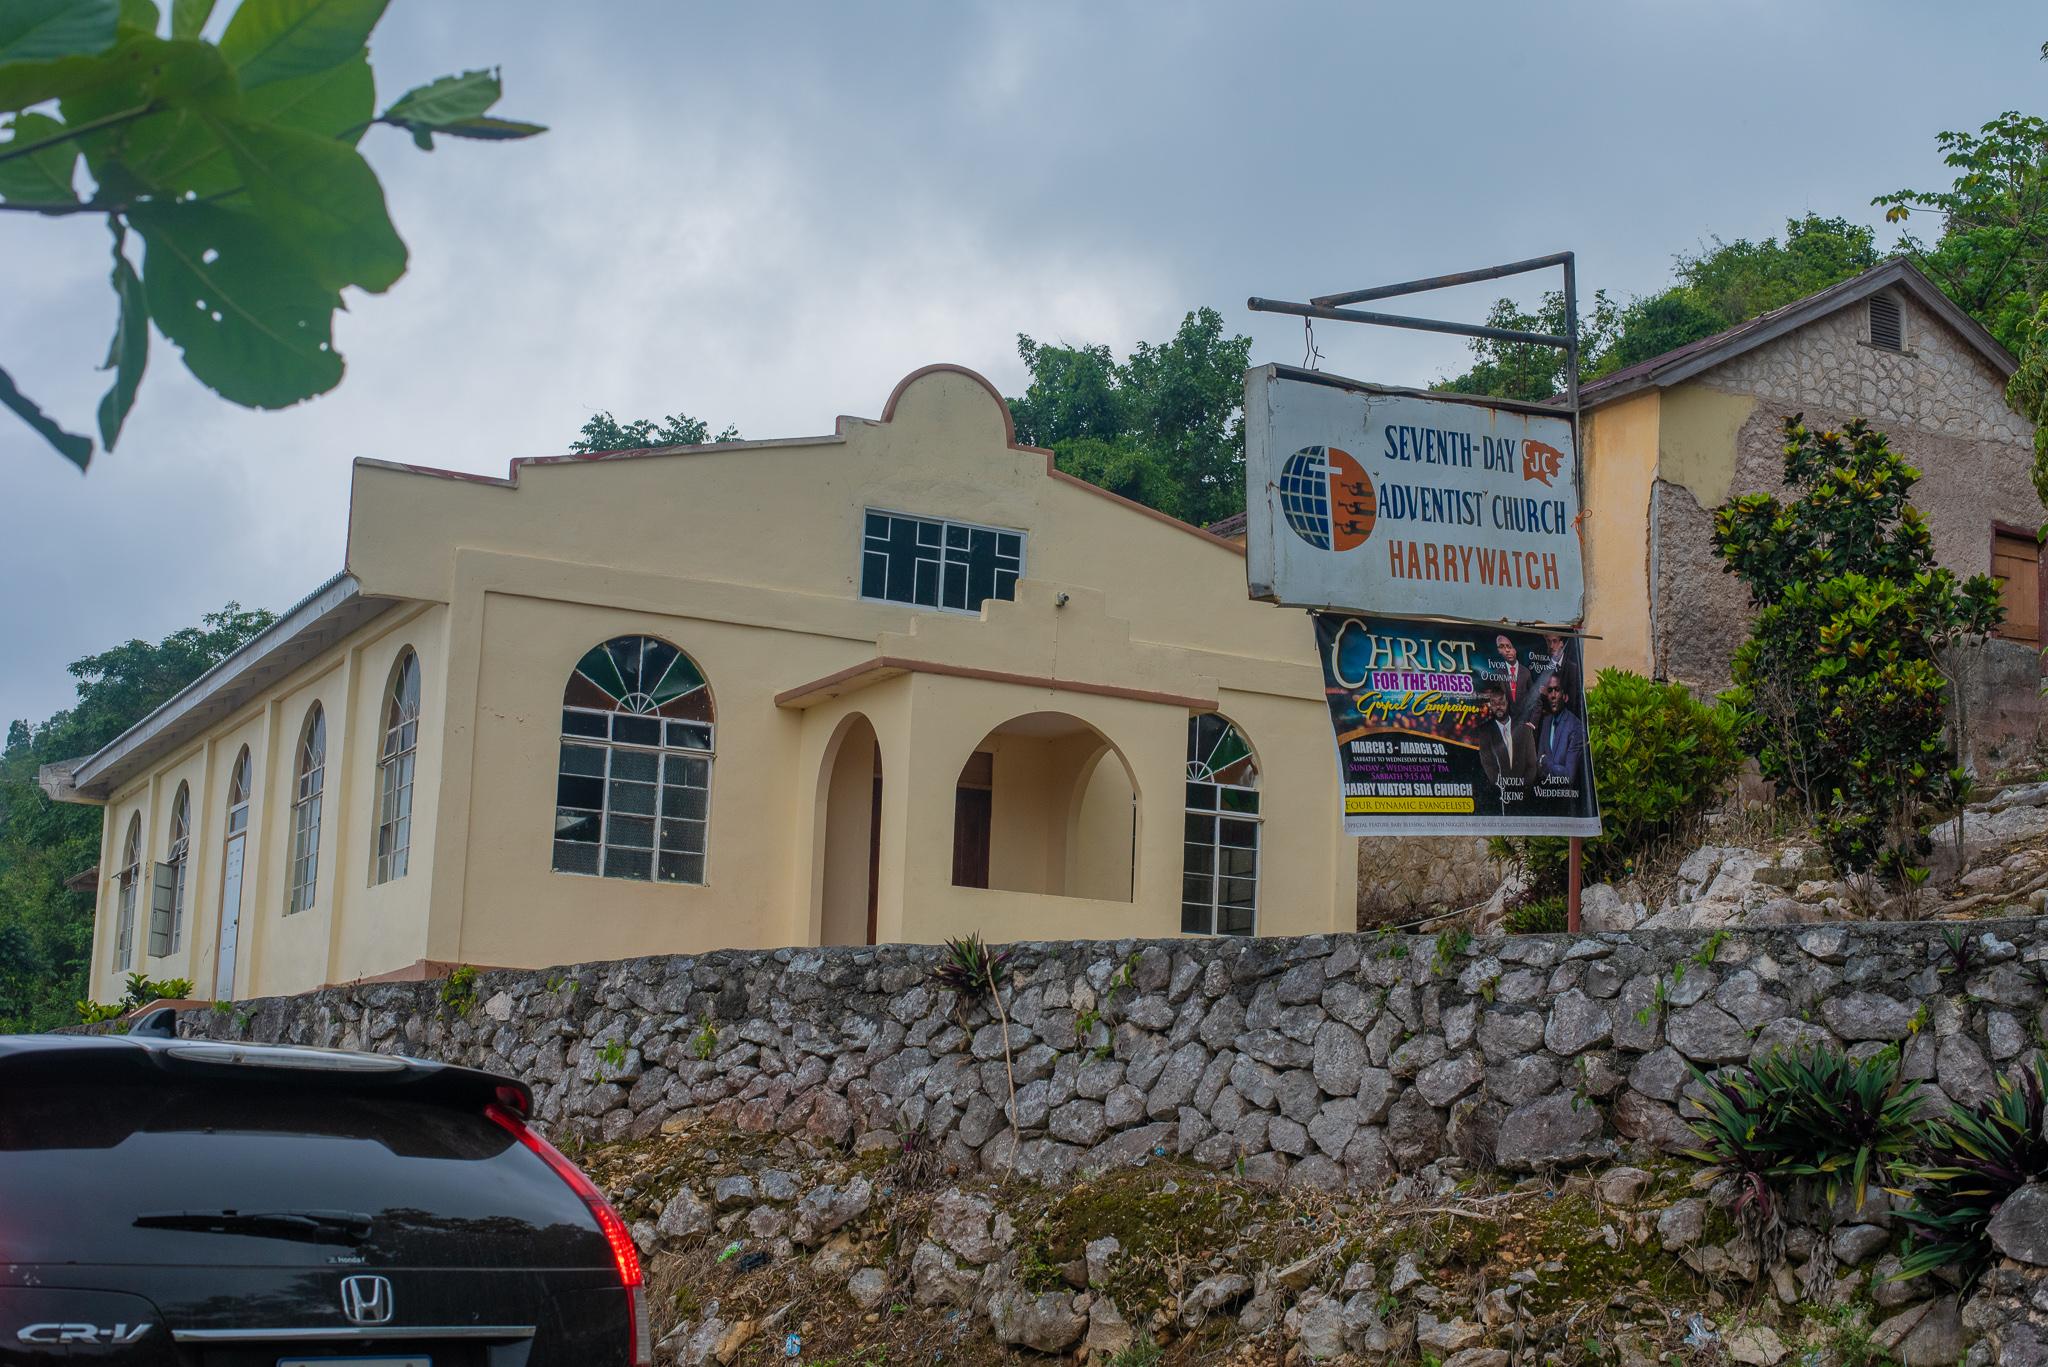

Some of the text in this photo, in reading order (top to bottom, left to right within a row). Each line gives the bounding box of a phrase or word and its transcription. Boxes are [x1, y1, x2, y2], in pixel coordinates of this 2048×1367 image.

[1384, 425, 1516, 473] SEVENTH-DAY
[1378, 482, 1567, 535] ADVENTIST CHURCH
[1388, 540, 1560, 590] HARRYWATCH
[1331, 618, 1476, 689] CHRIST
[1372, 672, 1474, 693] FOR THE CRISES
[1357, 690, 1414, 721] Gospel
[1351, 741, 1386, 754] MARCH
[1386, 742, 1394, 754] 3
[1400, 742, 1433, 755] MARCH
[1349, 764, 1379, 772] SUNDAY
[1386, 763, 1431, 772] WEDNESDAY
[1432, 764, 1437, 772] 7
[1371, 772, 1403, 780] SABBATH
[1344, 783, 1473, 796] HARRY WATCH SDA CHURCH
[1346, 800, 1471, 810] FOUR DYNAMIC EVANGELISTS
[16, 1322, 153, 1344] CR-V
